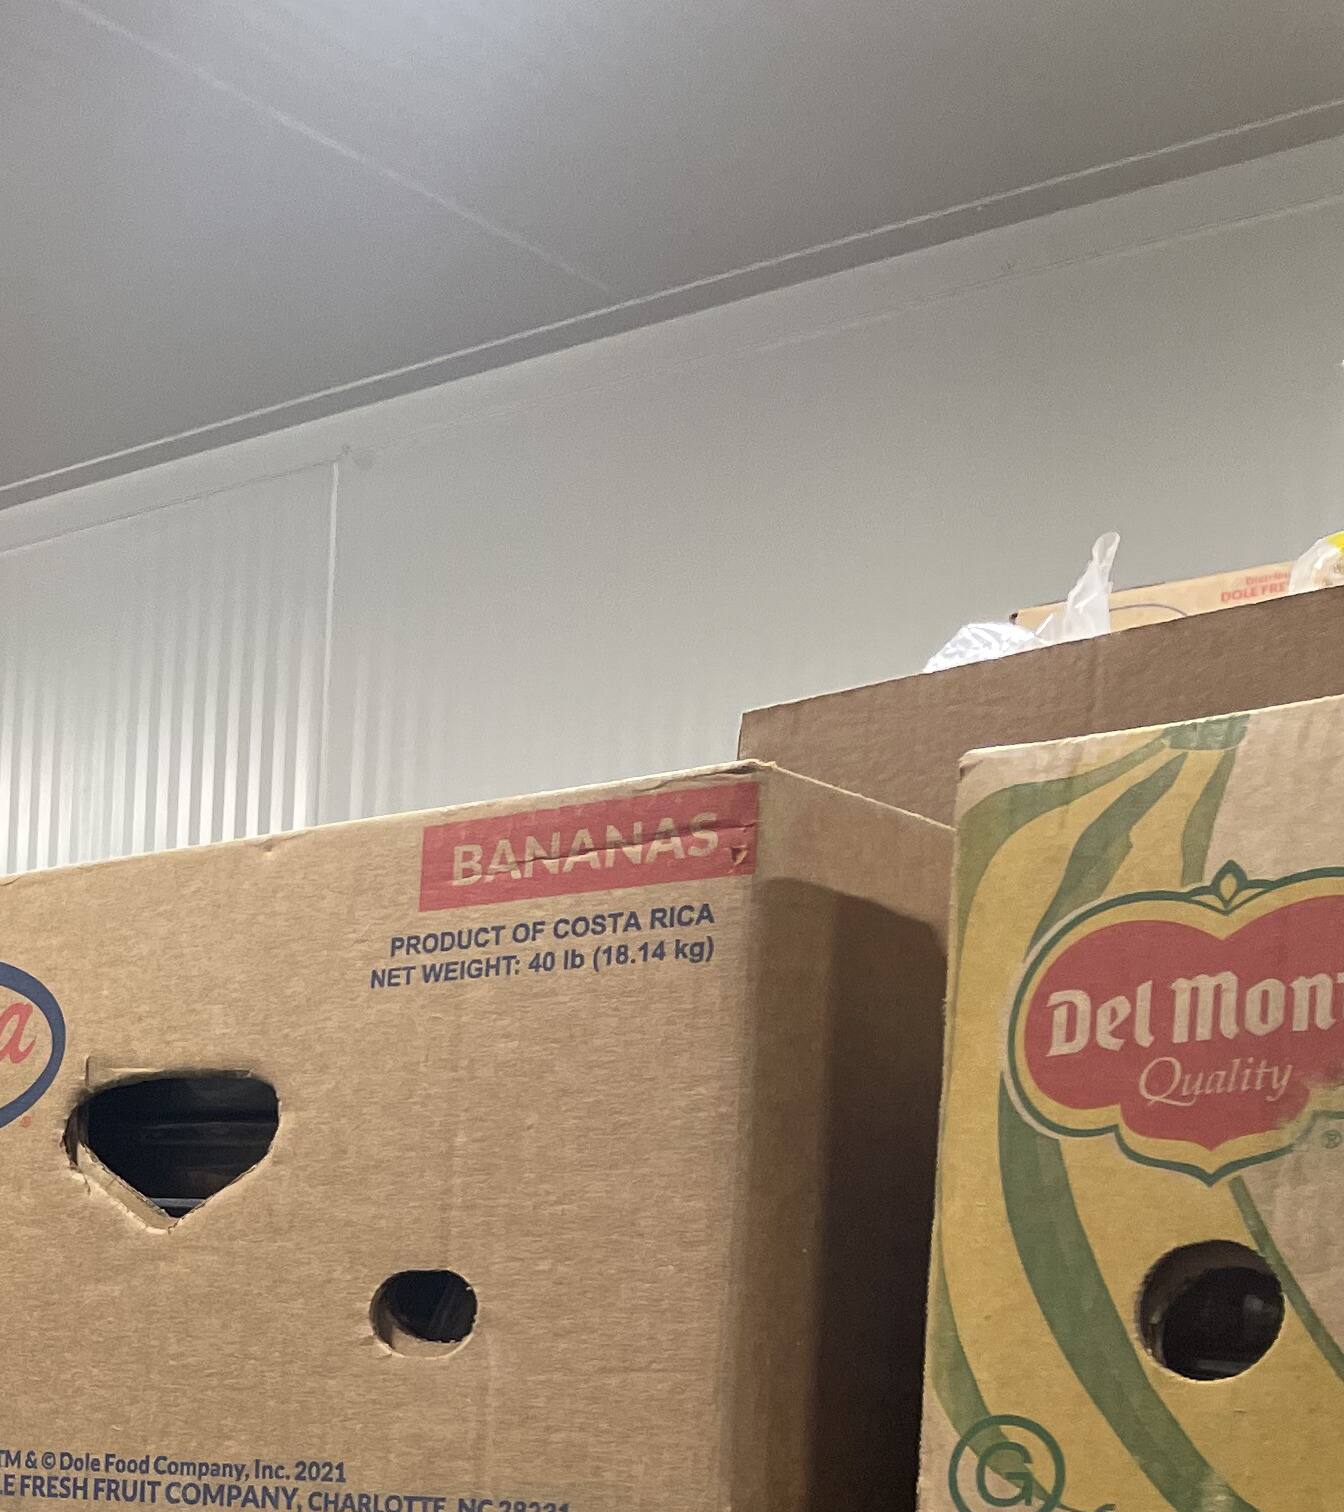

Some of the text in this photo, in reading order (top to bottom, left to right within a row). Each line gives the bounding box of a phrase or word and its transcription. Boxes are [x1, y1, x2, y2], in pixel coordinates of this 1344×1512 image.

[452, 810, 720, 888] BANANAS
[390, 902, 715, 961] PRODUCT OF COSTA RICA
[369, 934, 715, 990] NET WEIGHT: 40 lb (18.14 kg)
[1045, 981, 1154, 1057] Del
[1138, 1056, 1294, 1108] Quality
[19, 1475, 88, 1500] FRESH
[92, 1477, 161, 1505] FRUIT
[24, 1452, 37, 1469] &
[59, 1451, 100, 1472] Dole
[104, 1453, 150, 1475] Food
[153, 1455, 251, 1483] Company,
[254, 1459, 291, 1482] Inc.
[294, 1461, 346, 1483] 2021
